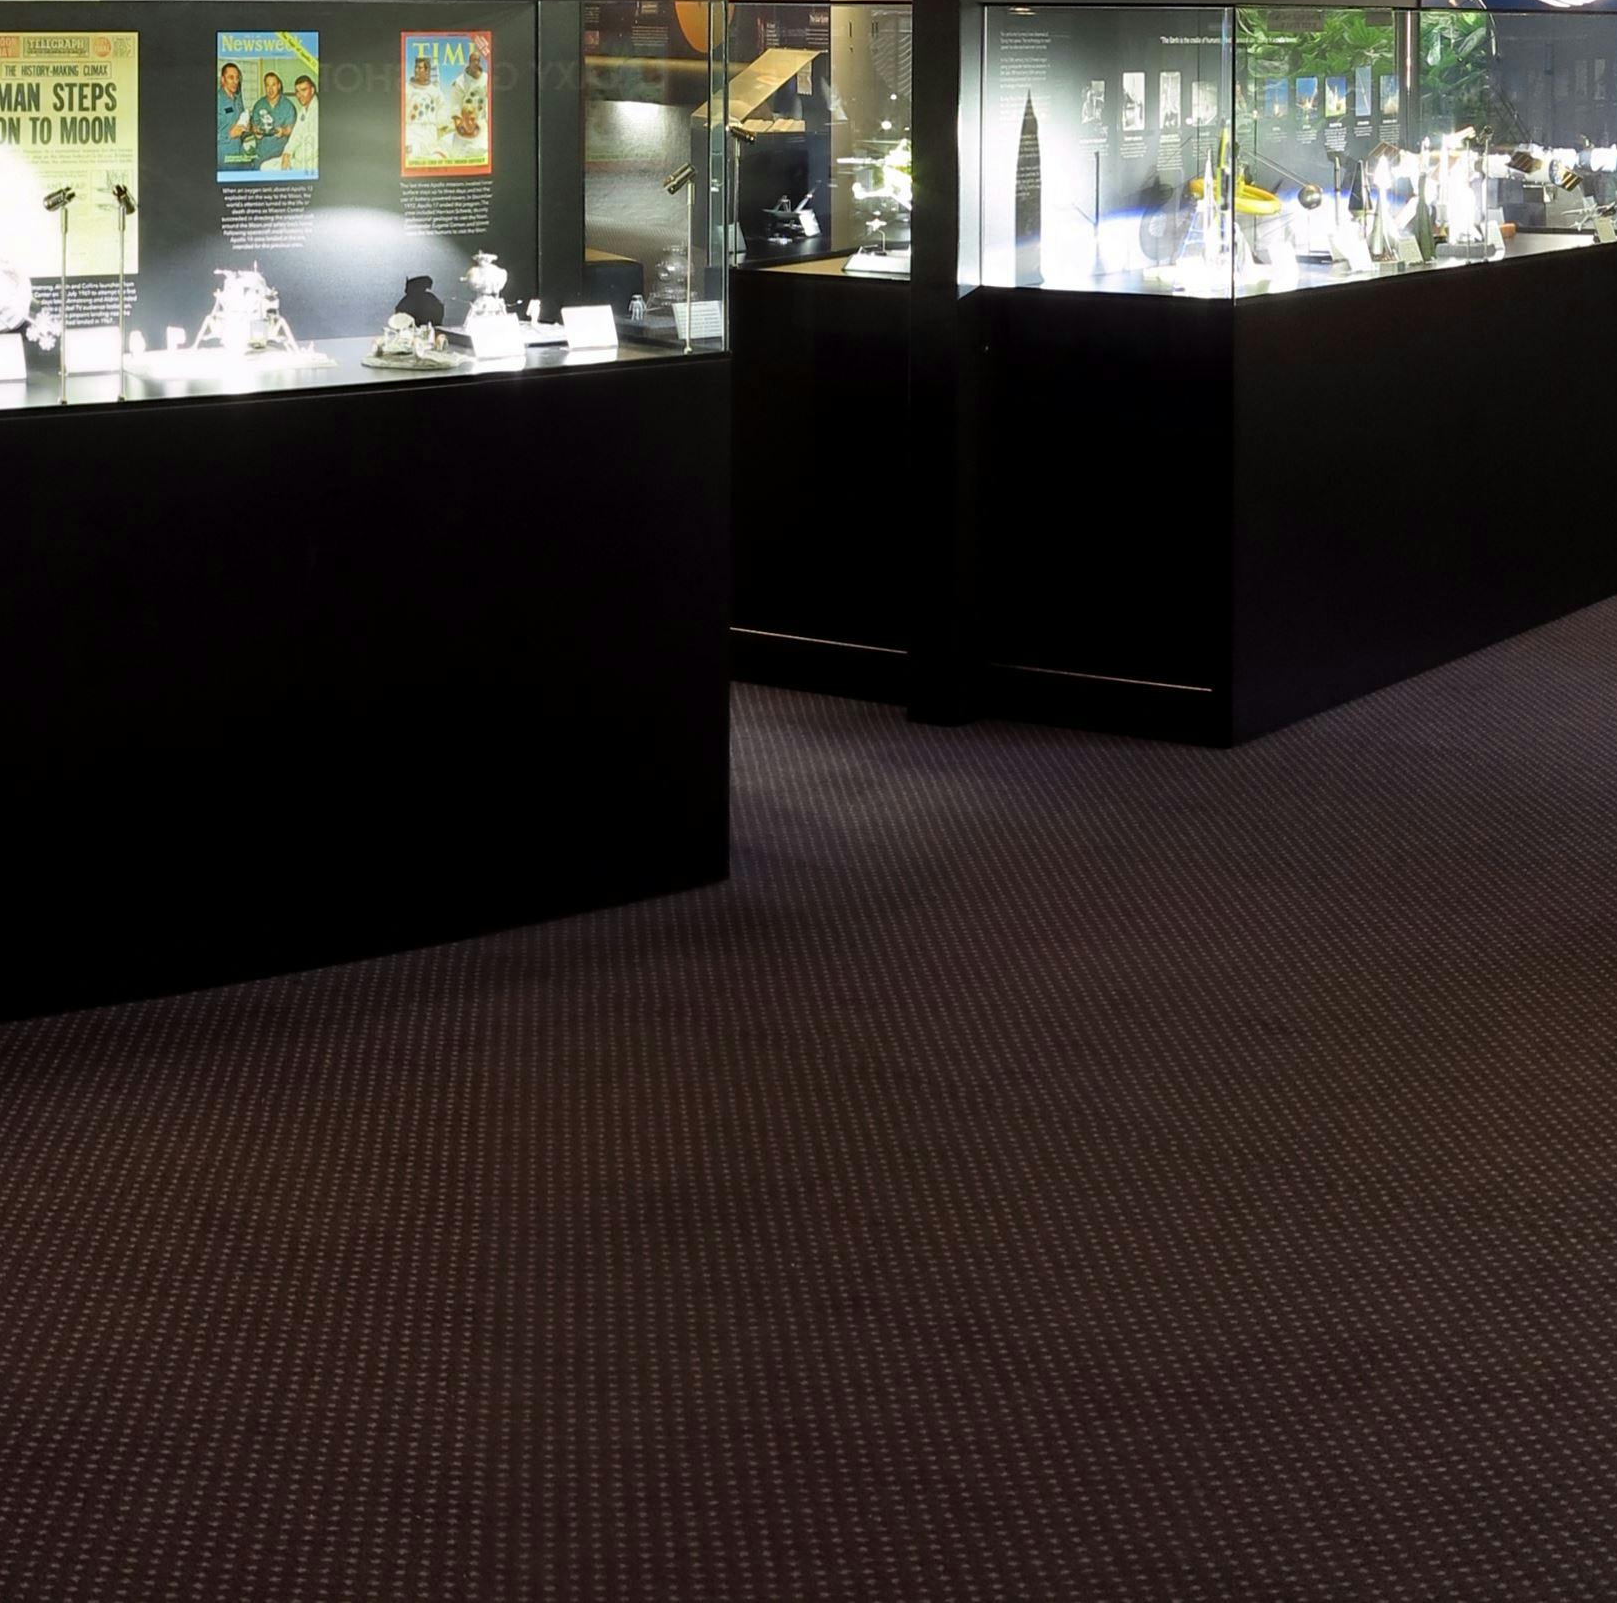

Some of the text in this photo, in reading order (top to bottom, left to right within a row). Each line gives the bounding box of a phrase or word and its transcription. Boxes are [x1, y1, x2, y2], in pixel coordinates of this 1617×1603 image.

[29, 38, 84, 49] TELEGRAPH
[5, 65, 108, 76] THE HISTORY-MAKING CLIMAX
[53, 82, 117, 112] STEPS
[29, 117, 51, 145] TO
[60, 116, 116, 145] MOON
